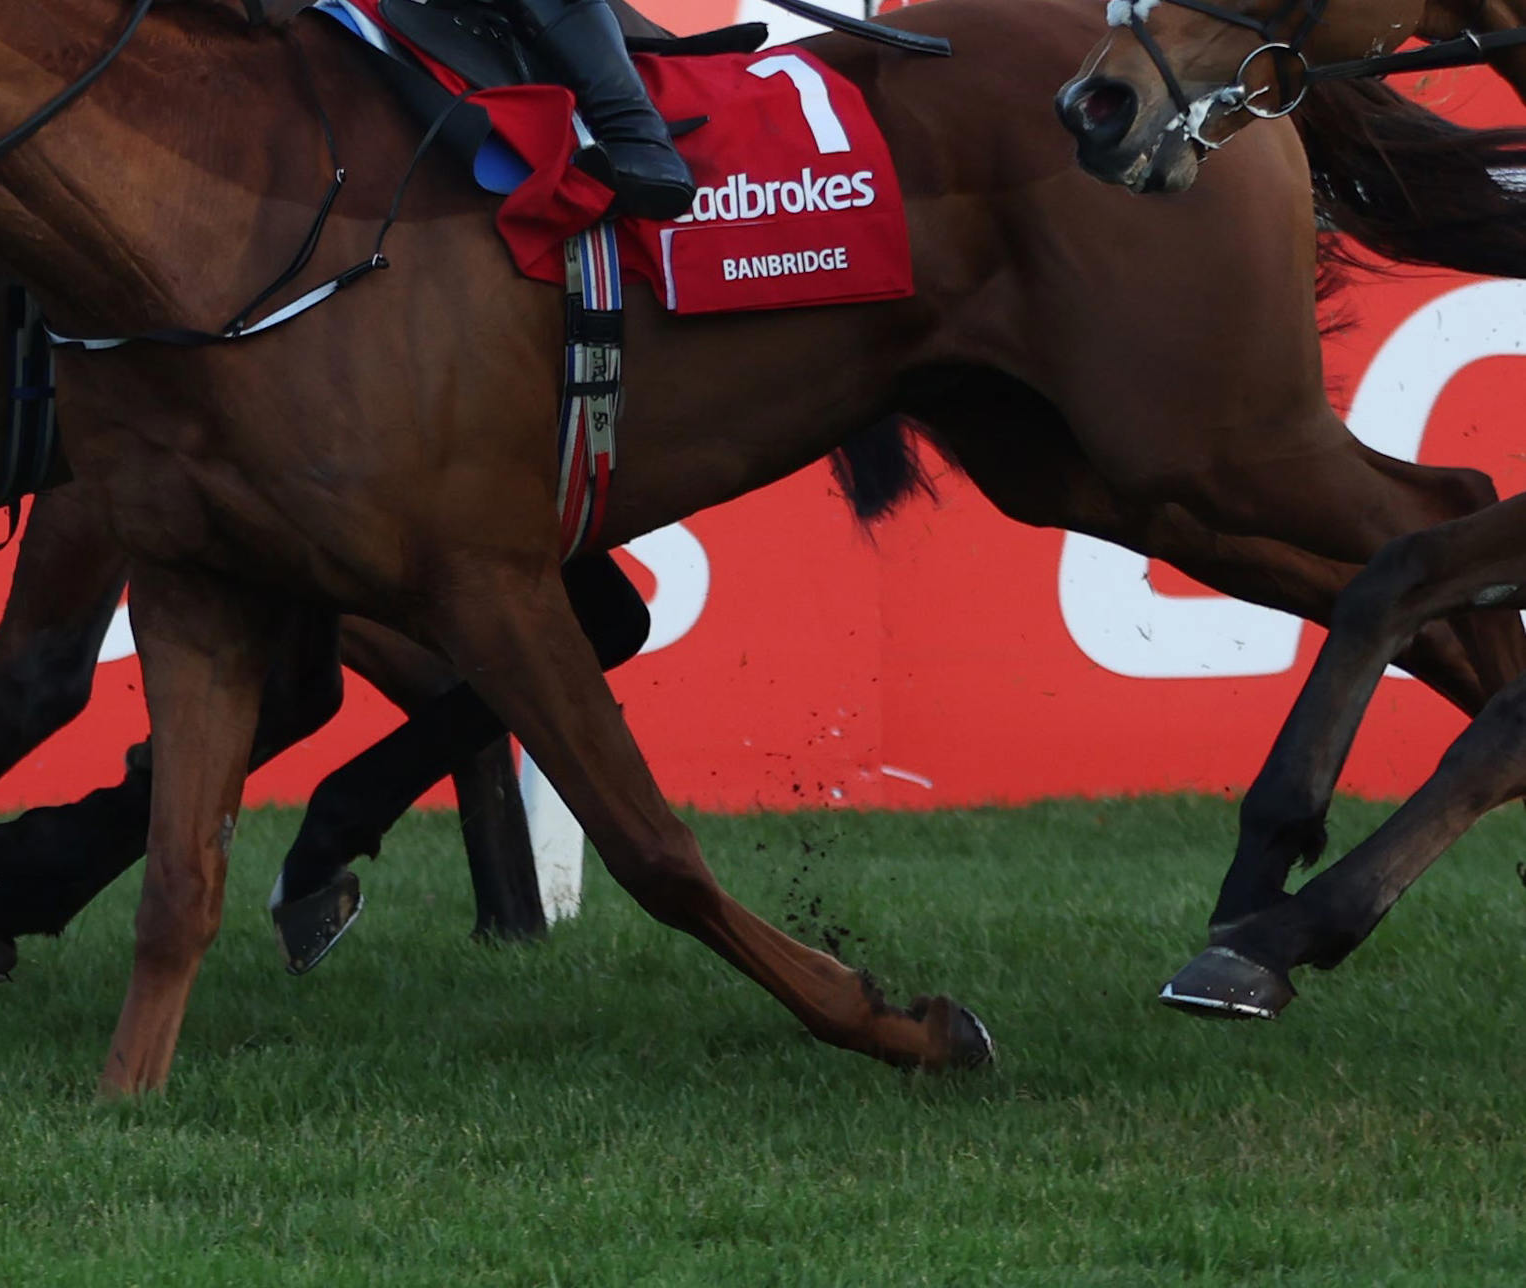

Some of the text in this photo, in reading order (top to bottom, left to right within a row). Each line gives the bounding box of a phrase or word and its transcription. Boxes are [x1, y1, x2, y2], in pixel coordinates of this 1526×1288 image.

[745, 53, 852, 155] 1
[673, 167, 876, 223] adbrokes
[723, 247, 848, 281] BANBRIDGE
